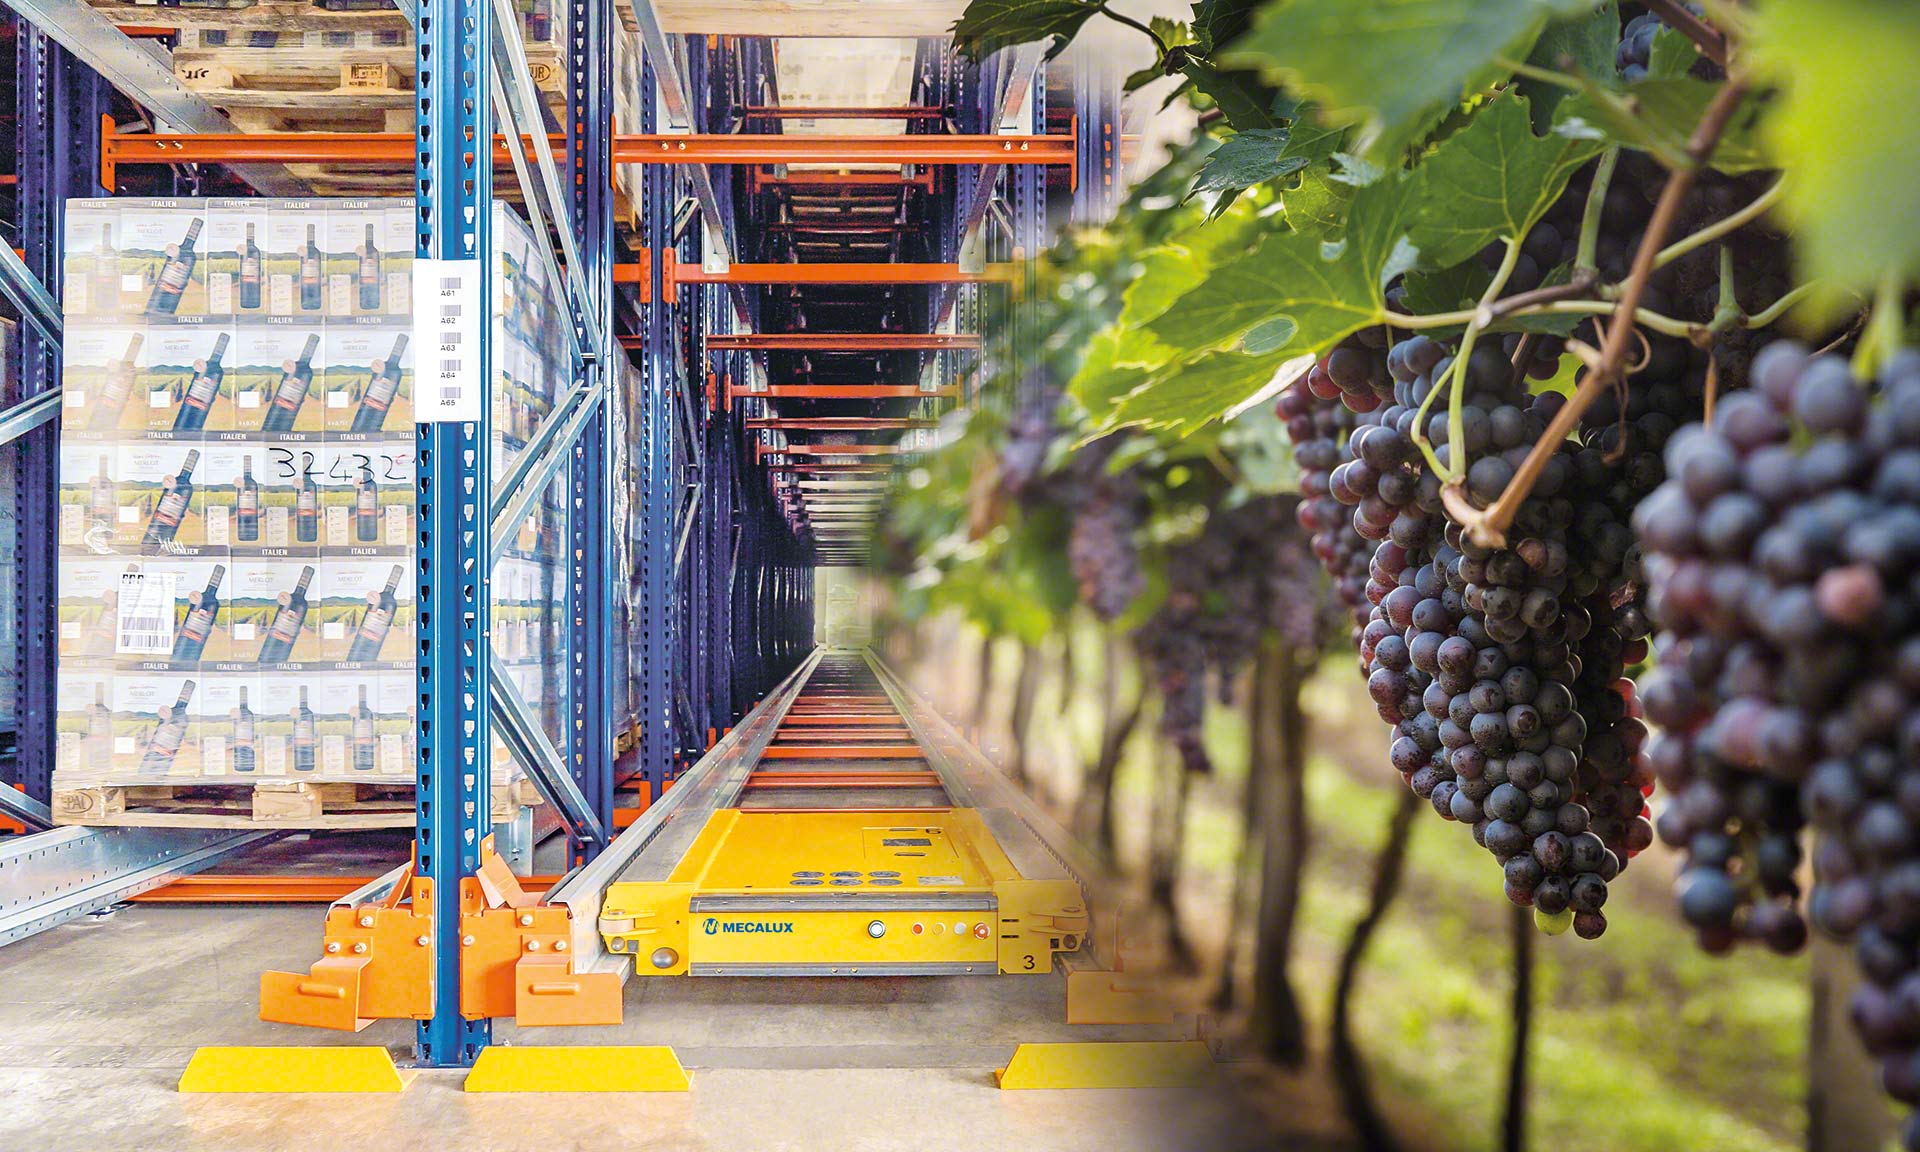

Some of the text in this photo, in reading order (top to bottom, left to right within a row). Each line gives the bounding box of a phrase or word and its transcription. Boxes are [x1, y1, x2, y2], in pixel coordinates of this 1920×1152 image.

[223, 200, 250, 208] ITALIEN
[280, 433, 305, 441] ITALIEN
[340, 433, 366, 441] ITALIEN
[393, 661, 415, 669] ITALIE
[723, 922, 793, 933] MECALUX
[1023, 955, 1035, 970] 3
